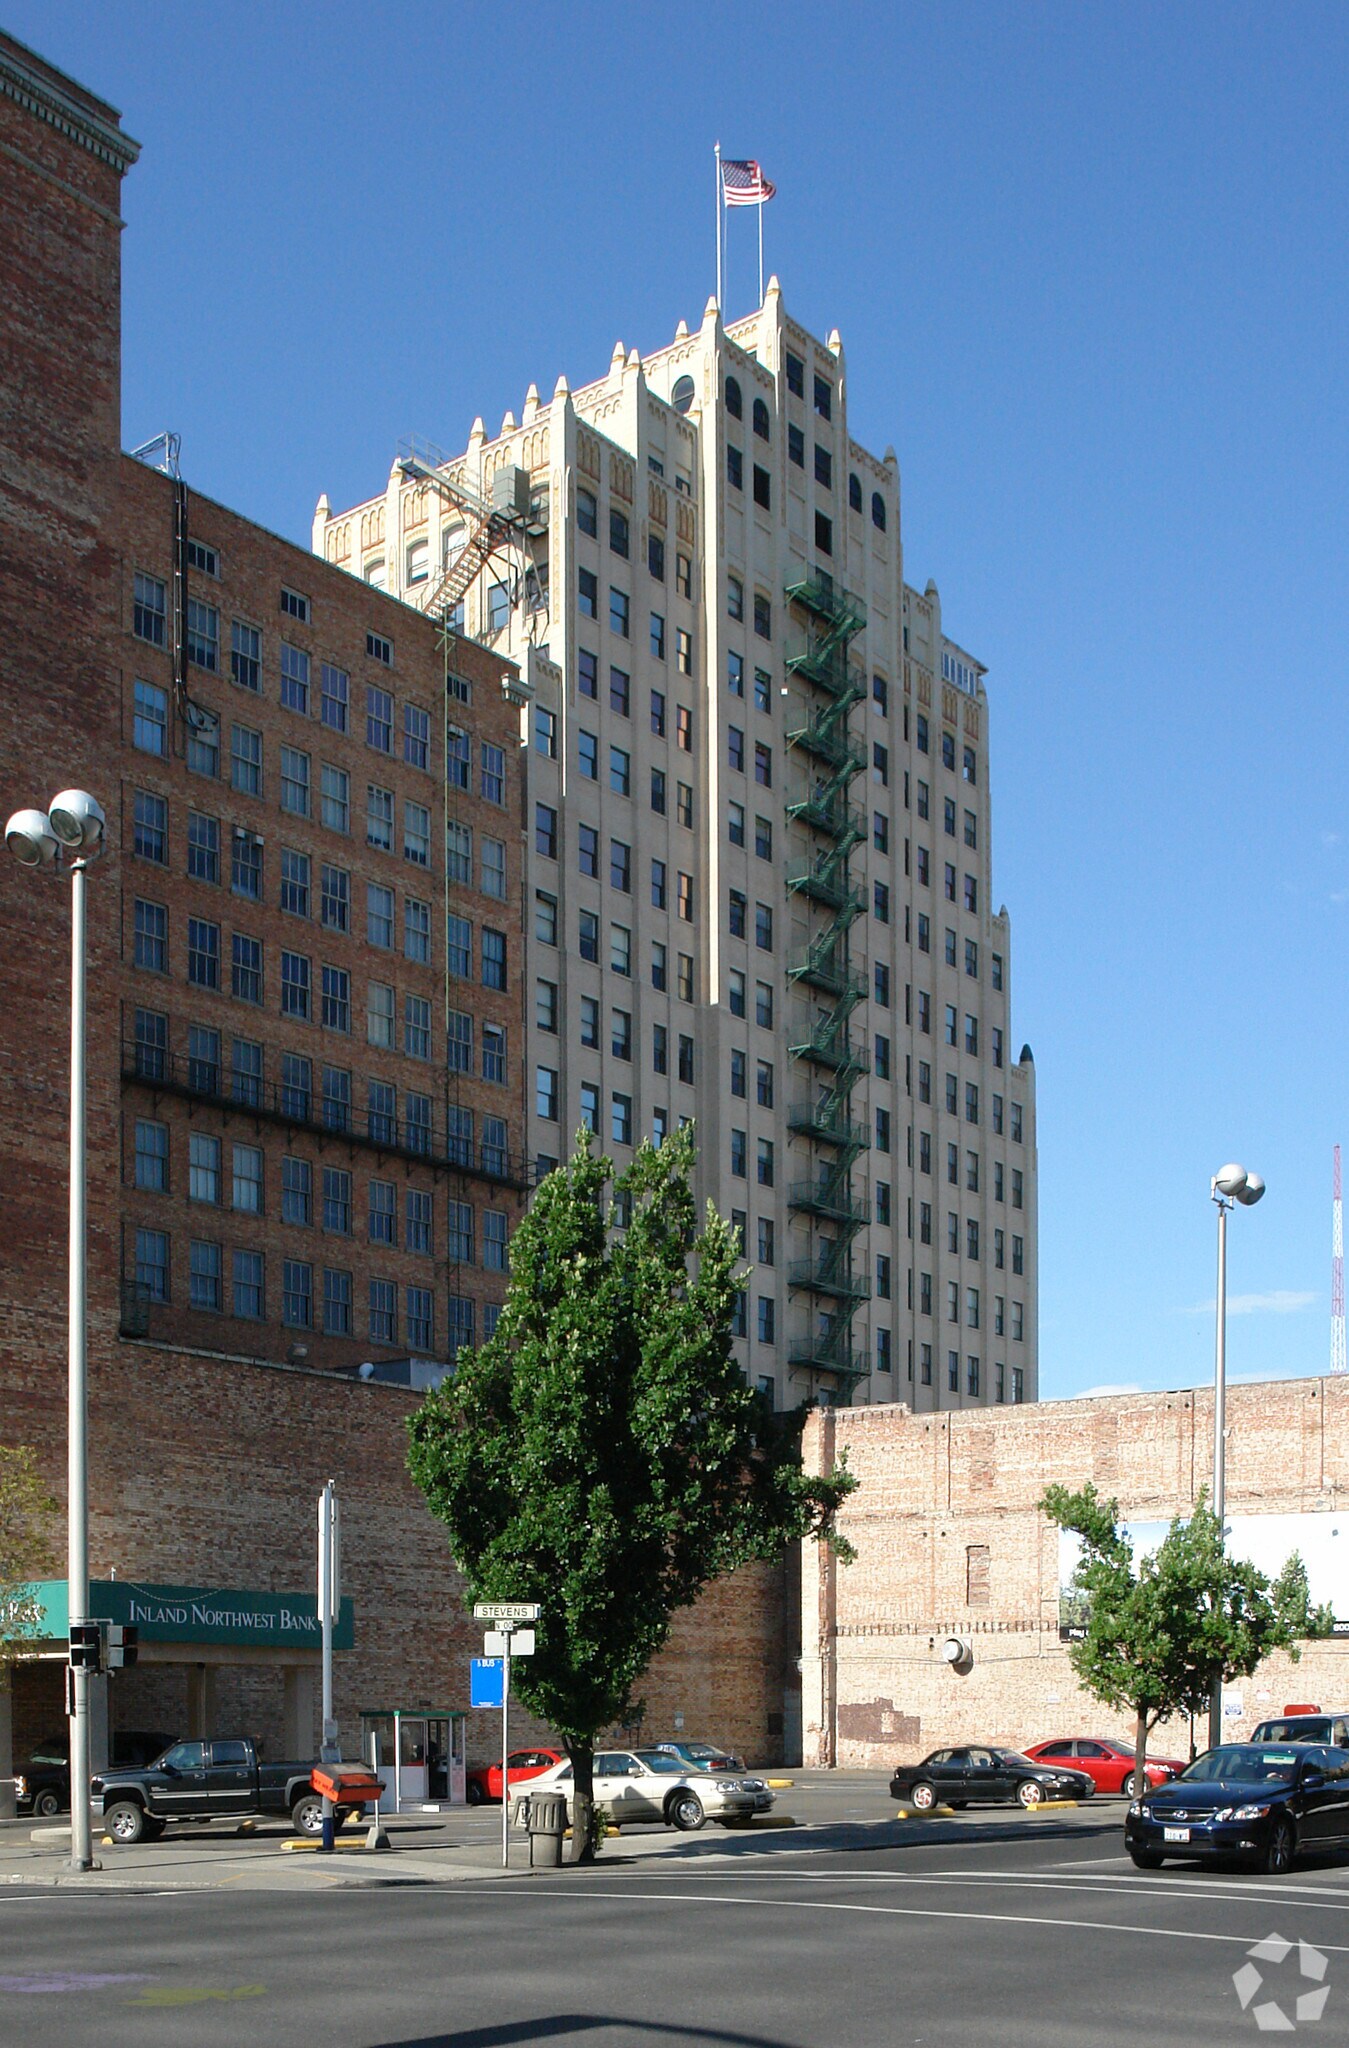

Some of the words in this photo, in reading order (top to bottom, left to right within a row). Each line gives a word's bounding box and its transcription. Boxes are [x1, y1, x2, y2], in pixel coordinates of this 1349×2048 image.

[129, 1600, 187, 1624] INLAND
[191, 1604, 276, 1628] NORTHWEST
[280, 1609, 317, 1631] BANK
[482, 1607, 528, 1617] STEVENS
